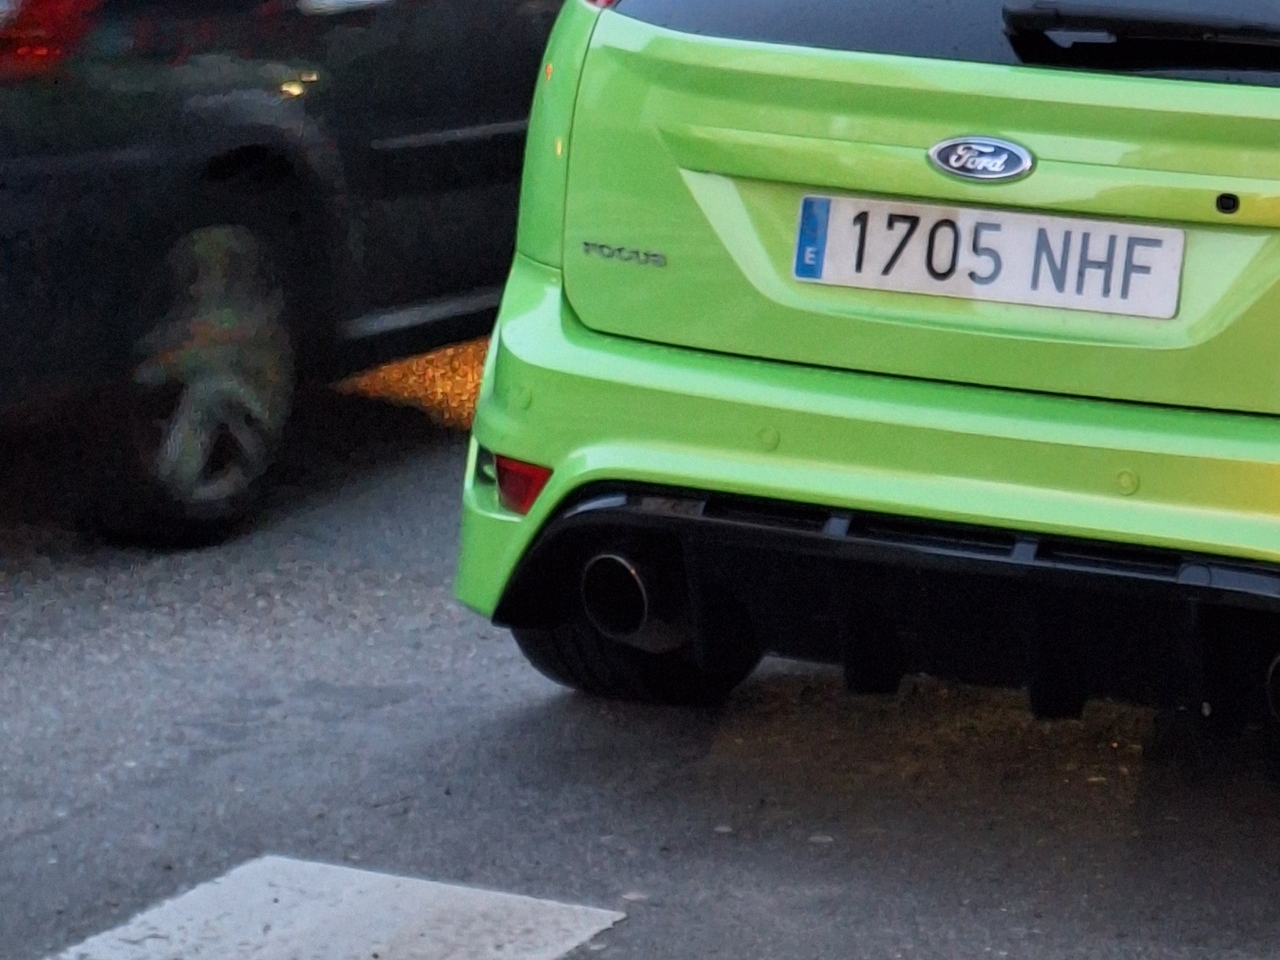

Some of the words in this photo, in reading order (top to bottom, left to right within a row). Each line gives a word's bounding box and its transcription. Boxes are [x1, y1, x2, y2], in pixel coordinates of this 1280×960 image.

[948, 144, 1009, 172] Ford
[582, 241, 667, 267] FOCUS
[804, 250, 816, 266] E
[852, 211, 1003, 286] 1705
[1030, 227, 1163, 300] NHF
